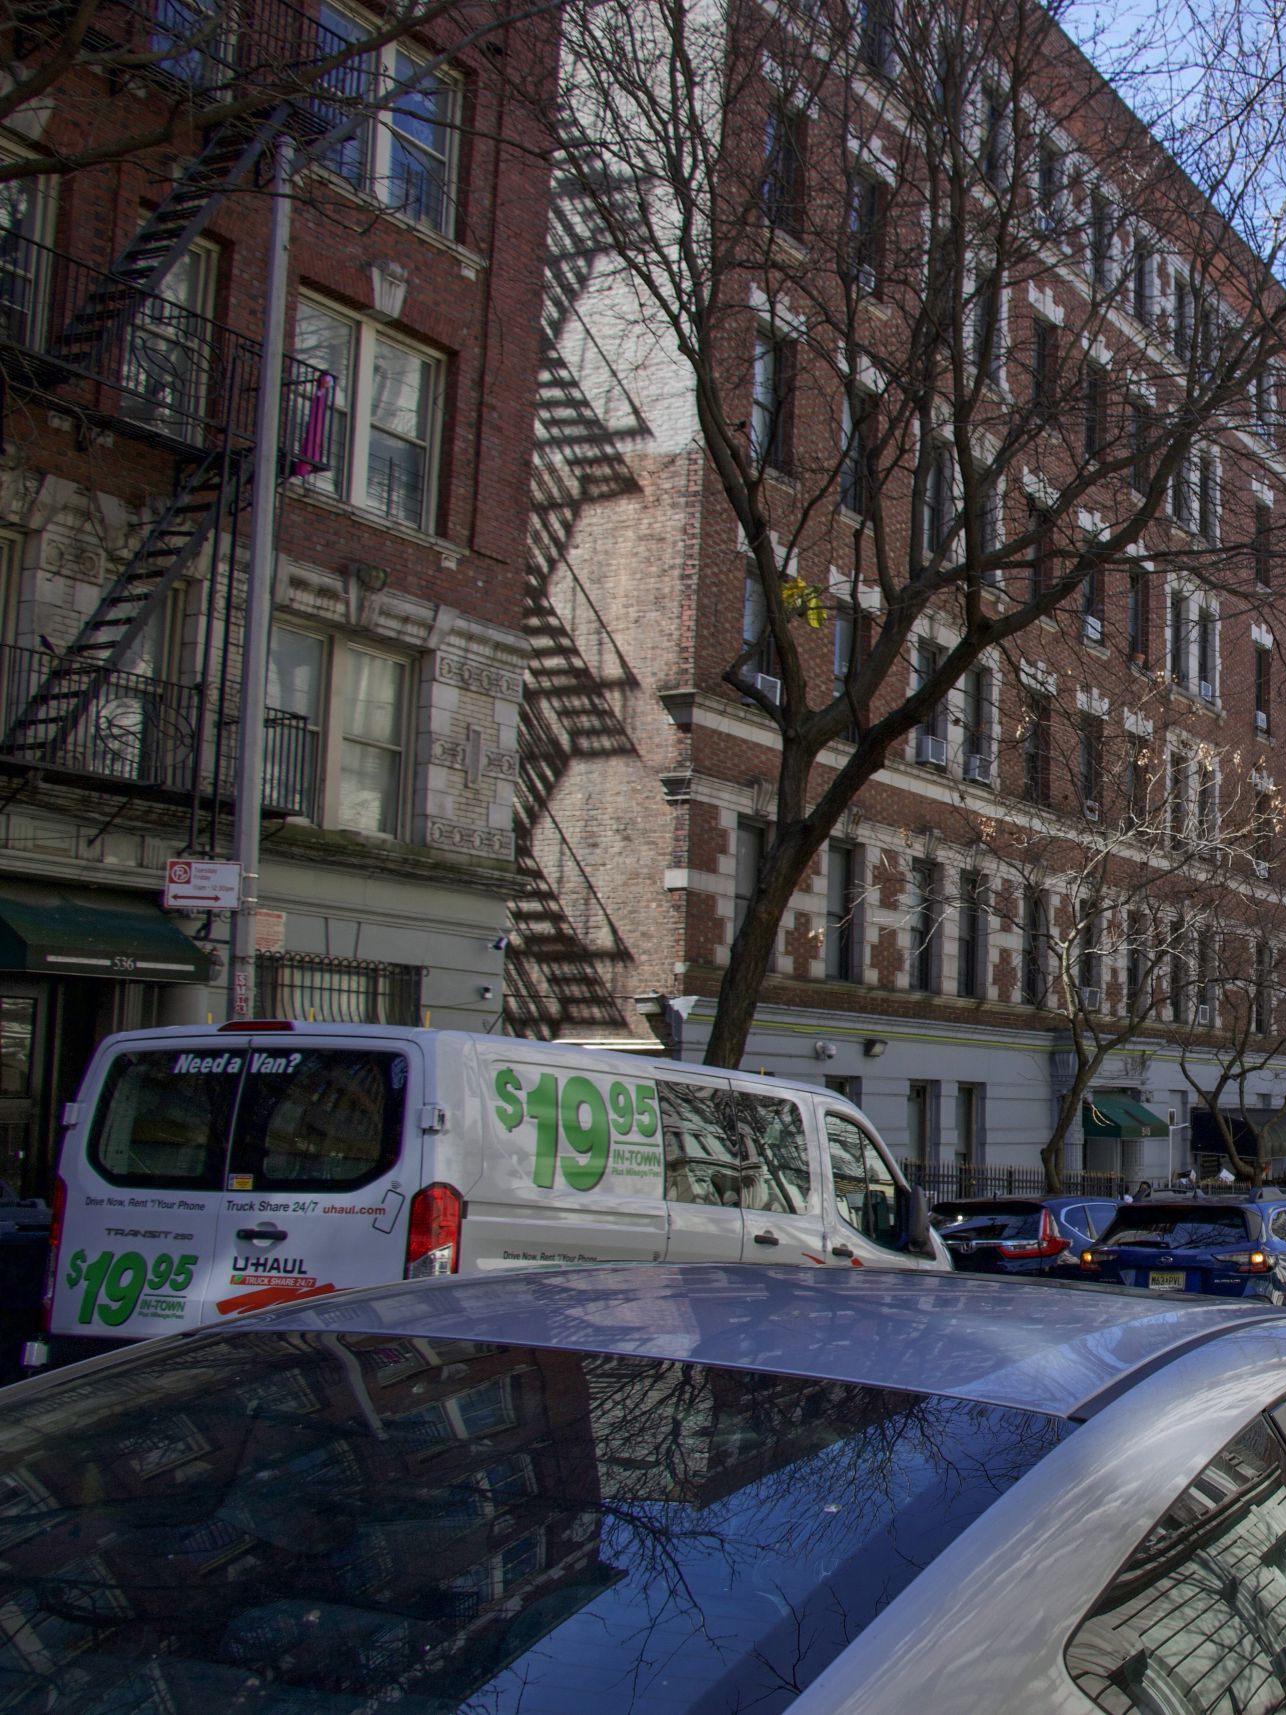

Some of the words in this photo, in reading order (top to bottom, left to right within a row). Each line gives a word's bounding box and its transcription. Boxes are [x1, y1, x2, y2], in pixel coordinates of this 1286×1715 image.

[113, 956, 134, 970] 536
[174, 1053, 228, 1073] Need
[227, 1058, 242, 1073] a
[250, 1053, 301, 1073] Van?
[613, 1149, 661, 1167] IN-TOWN
[85, 1196, 105, 1206] Drive
[127, 1198, 148, 1208] Rent
[177, 1200, 205, 1211] Phone
[226, 1200, 255, 1212] Truck
[257, 1200, 290, 1212] Share
[292, 1199, 319, 1214] 24/7
[323, 1205, 386, 1216] uhaul.com
[105, 1228, 172, 1239] TRANSIT
[503, 1251, 520, 1260] Drive
[540, 1252, 555, 1261] Rent
[577, 1254, 599, 1263] Phone
[232, 1256, 308, 1275] U-HAUL
[244, 1275, 269, 1285] TRUCK
[270, 1277, 295, 1286] SHARE
[296, 1278, 315, 1287] 24/7
[140, 1299, 186, 1312] IN-TOWN
